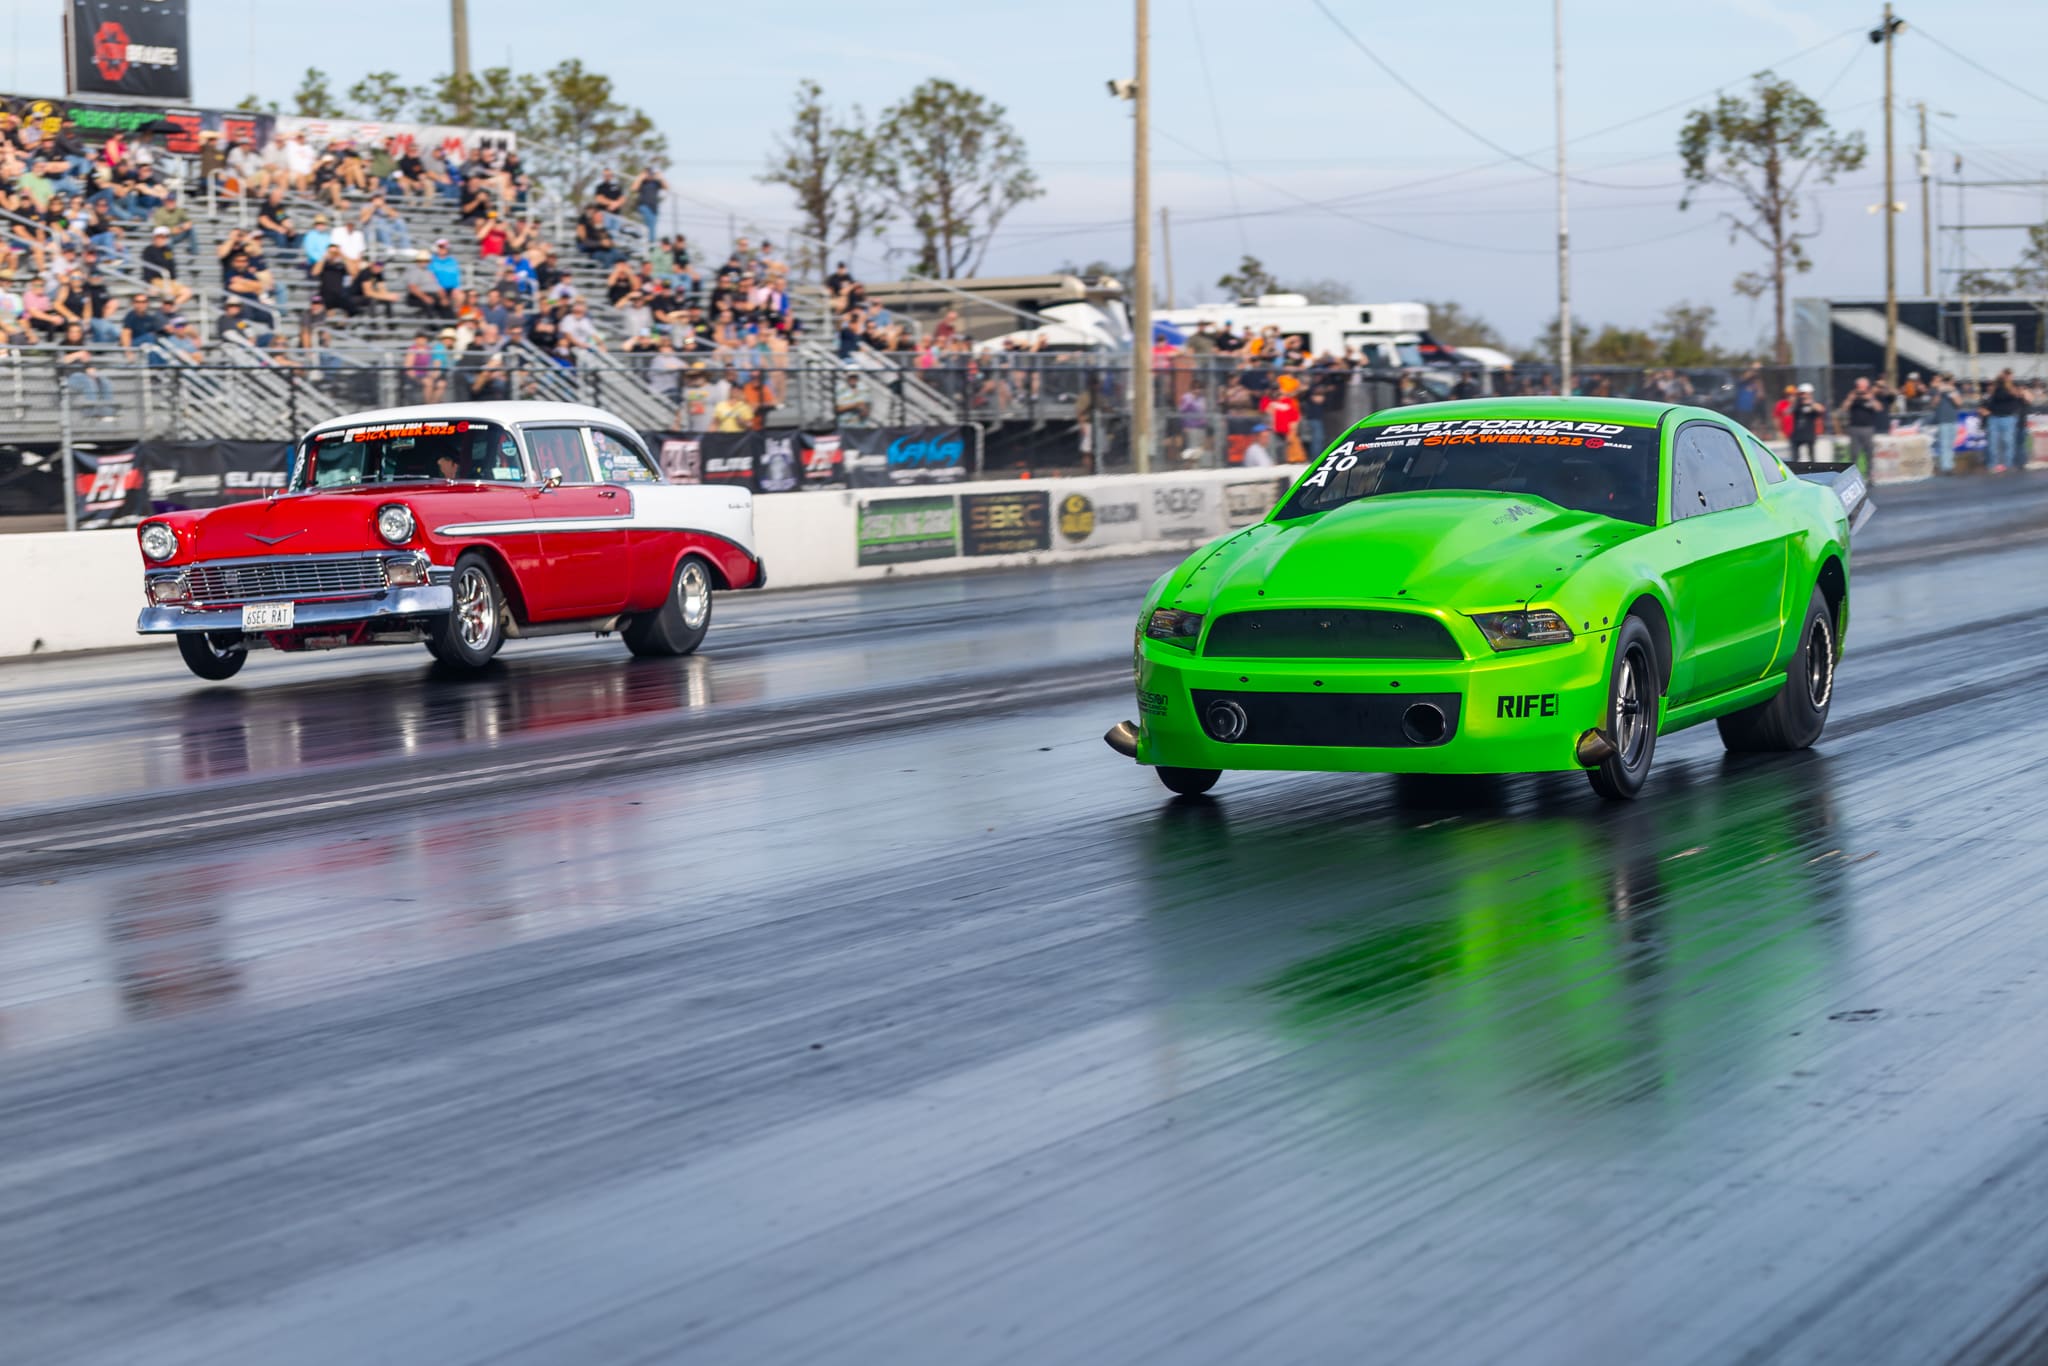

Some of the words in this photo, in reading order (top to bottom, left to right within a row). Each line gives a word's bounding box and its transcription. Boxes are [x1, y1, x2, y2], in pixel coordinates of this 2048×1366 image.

[354, 430, 387, 443] SICK
[388, 427, 422, 438] WEEK
[423, 425, 456, 435] 2025
[1381, 421, 1462, 435] FAST
[1461, 419, 1624, 434] FORWARD
[1426, 429, 1477, 437] RACE
[1475, 428, 1557, 436] ENGINES
[1423, 433, 1480, 446] SICK
[1479, 434, 1533, 443] WEEK
[1534, 435, 1584, 446] 2025
[1328, 441, 1355, 456] A
[705, 457, 753, 472] ELITE
[1317, 455, 1358, 471] 10
[225, 472, 287, 487] ELITE
[1302, 470, 1329, 487] A
[970, 503, 1042, 529] SBRC
[247, 610, 267, 625] 6SEC
[272, 609, 287, 623] RAT
[1497, 693, 1555, 718] RIFE
